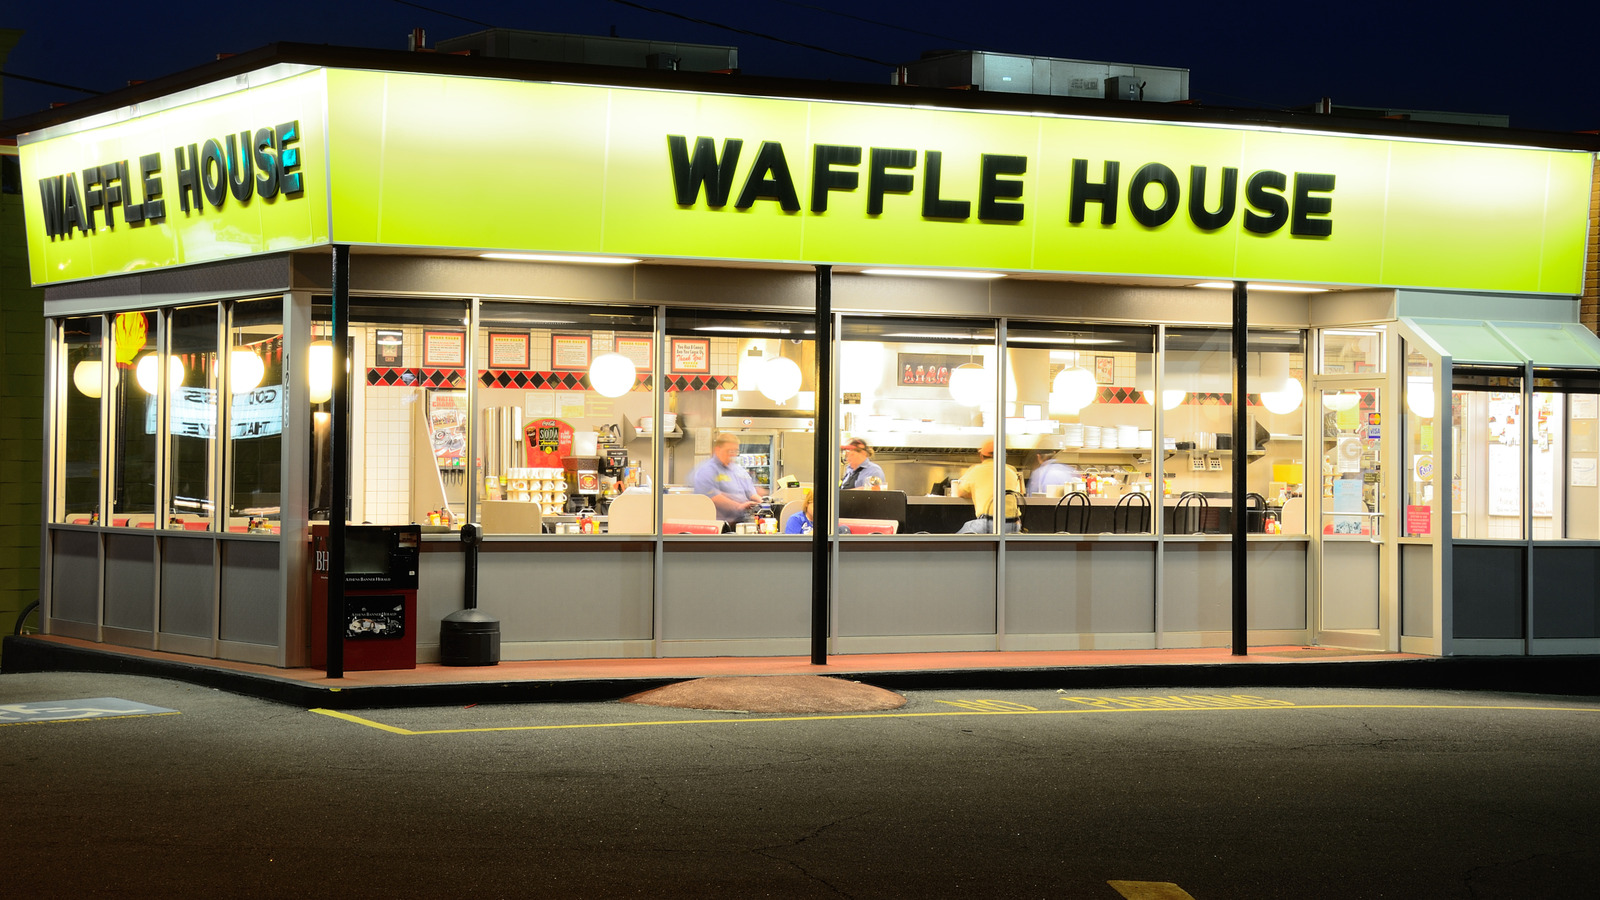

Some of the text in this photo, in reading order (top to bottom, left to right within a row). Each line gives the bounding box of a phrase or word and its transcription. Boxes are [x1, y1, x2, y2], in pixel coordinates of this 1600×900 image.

[39, 120, 304, 238] WAFFLE HOUSE
[666, 133, 1337, 237] WAFFLE HOUSE
[540, 428, 559, 440] SODA
